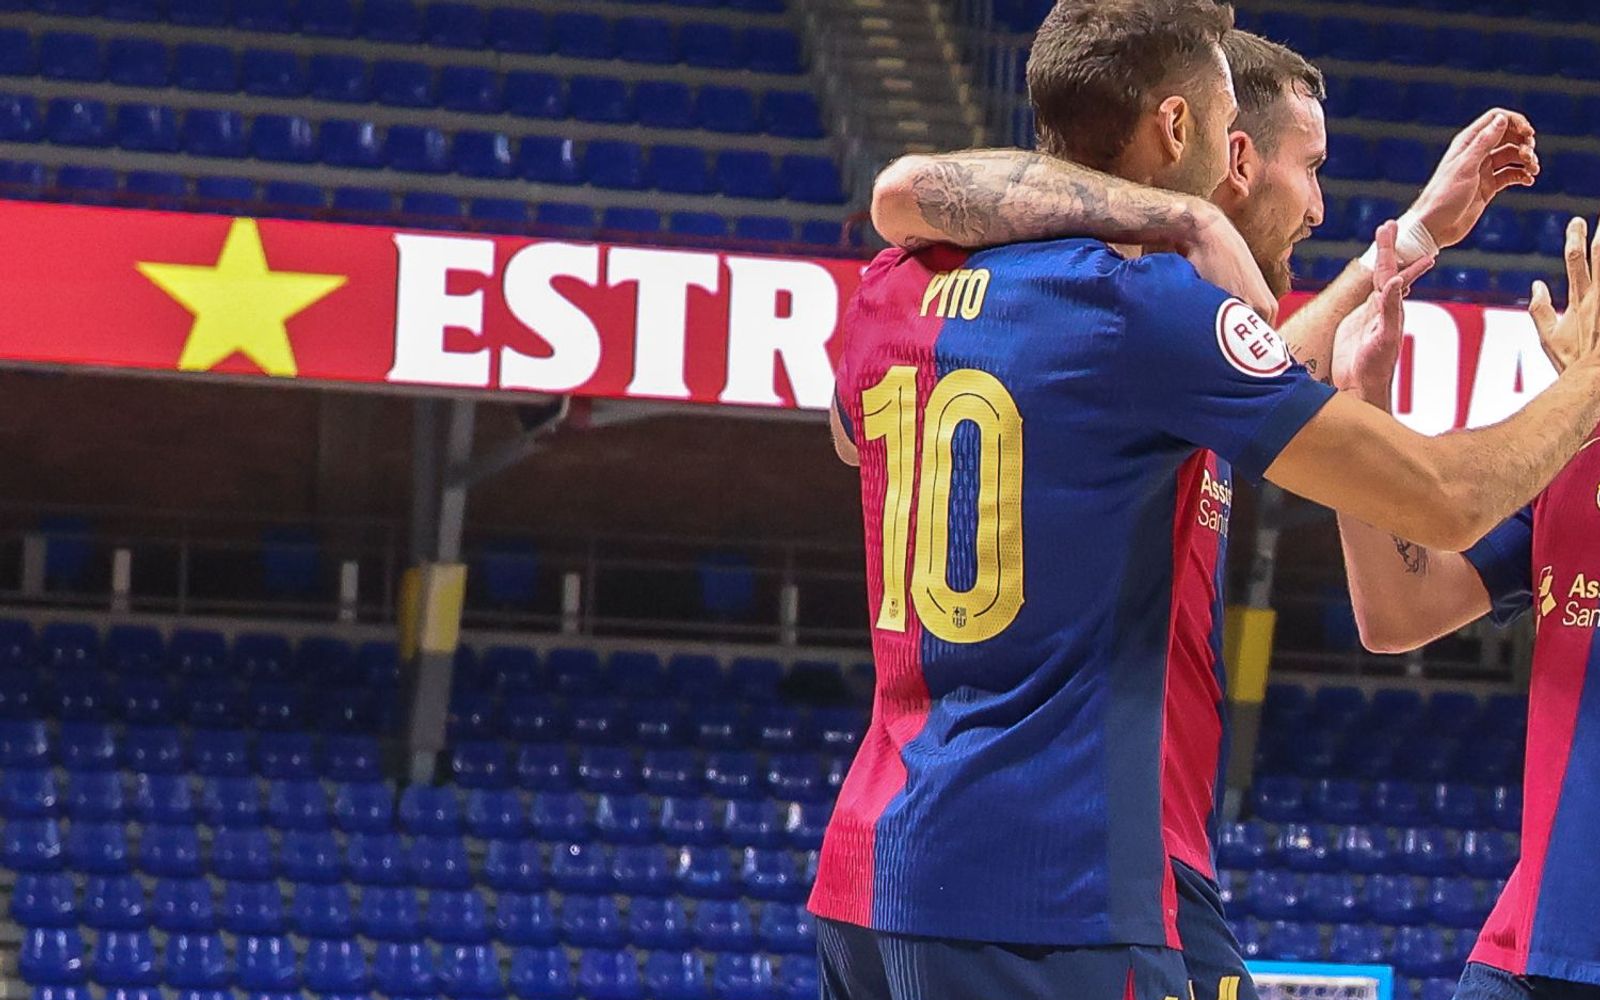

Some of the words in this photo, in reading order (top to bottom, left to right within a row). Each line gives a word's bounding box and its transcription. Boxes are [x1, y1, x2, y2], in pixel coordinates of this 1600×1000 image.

[387, 233, 862, 410] ESTR
[919, 268, 991, 320] PITO
[860, 364, 1025, 643] 10
